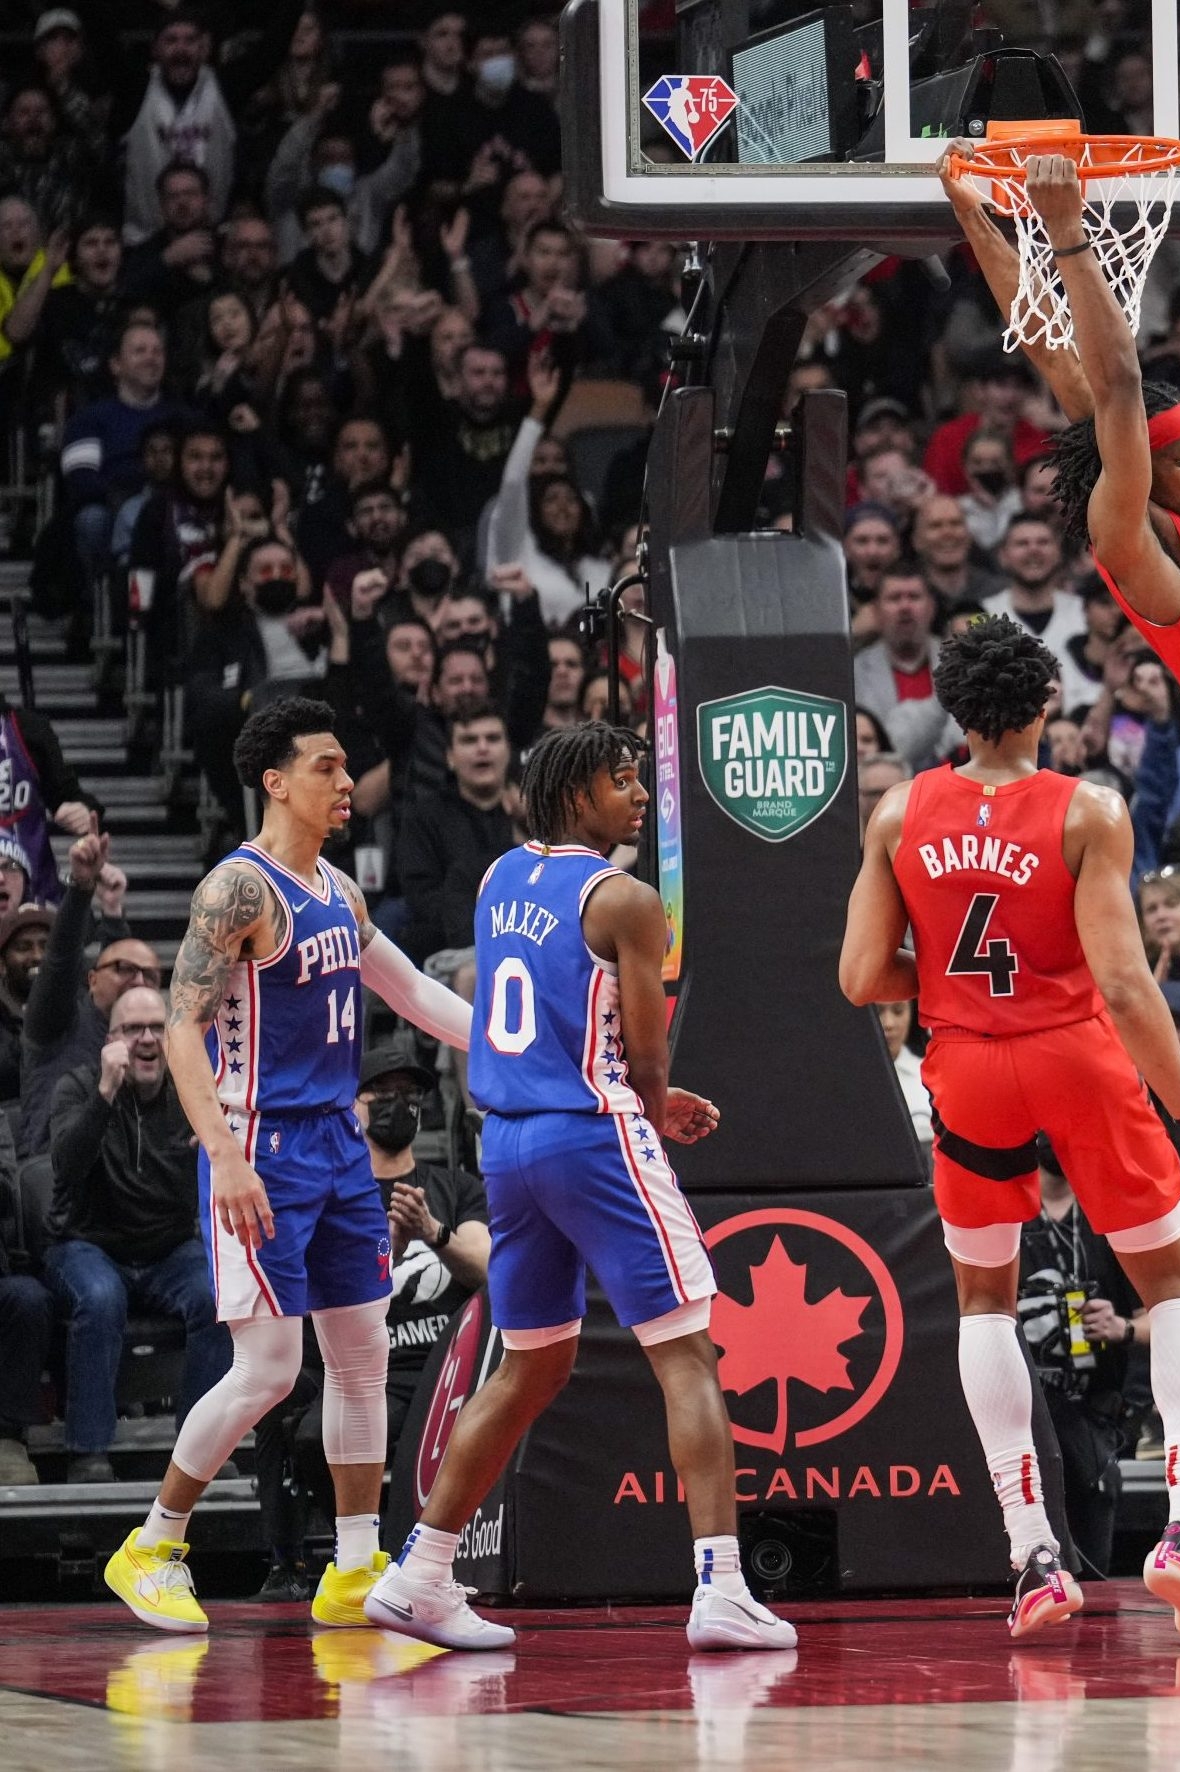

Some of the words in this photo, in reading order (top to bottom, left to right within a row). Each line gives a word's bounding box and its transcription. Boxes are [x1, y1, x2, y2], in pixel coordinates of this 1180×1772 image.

[700, 88, 717, 112] 75
[657, 713, 675, 759] BIO
[711, 711, 836, 760] FAMILY
[724, 759, 825, 798] GUARD
[752, 808, 797, 818] MARQUE
[918, 834, 1040, 886] BARNES
[491, 900, 559, 947] MAXEY
[945, 893, 1019, 997] 4
[327, 987, 355, 1044] 14
[486, 957, 537, 1056] 0
[614, 1471, 685, 1504] AI
[735, 1464, 961, 1502] CANADA
[472, 1503, 504, 1559] Good
